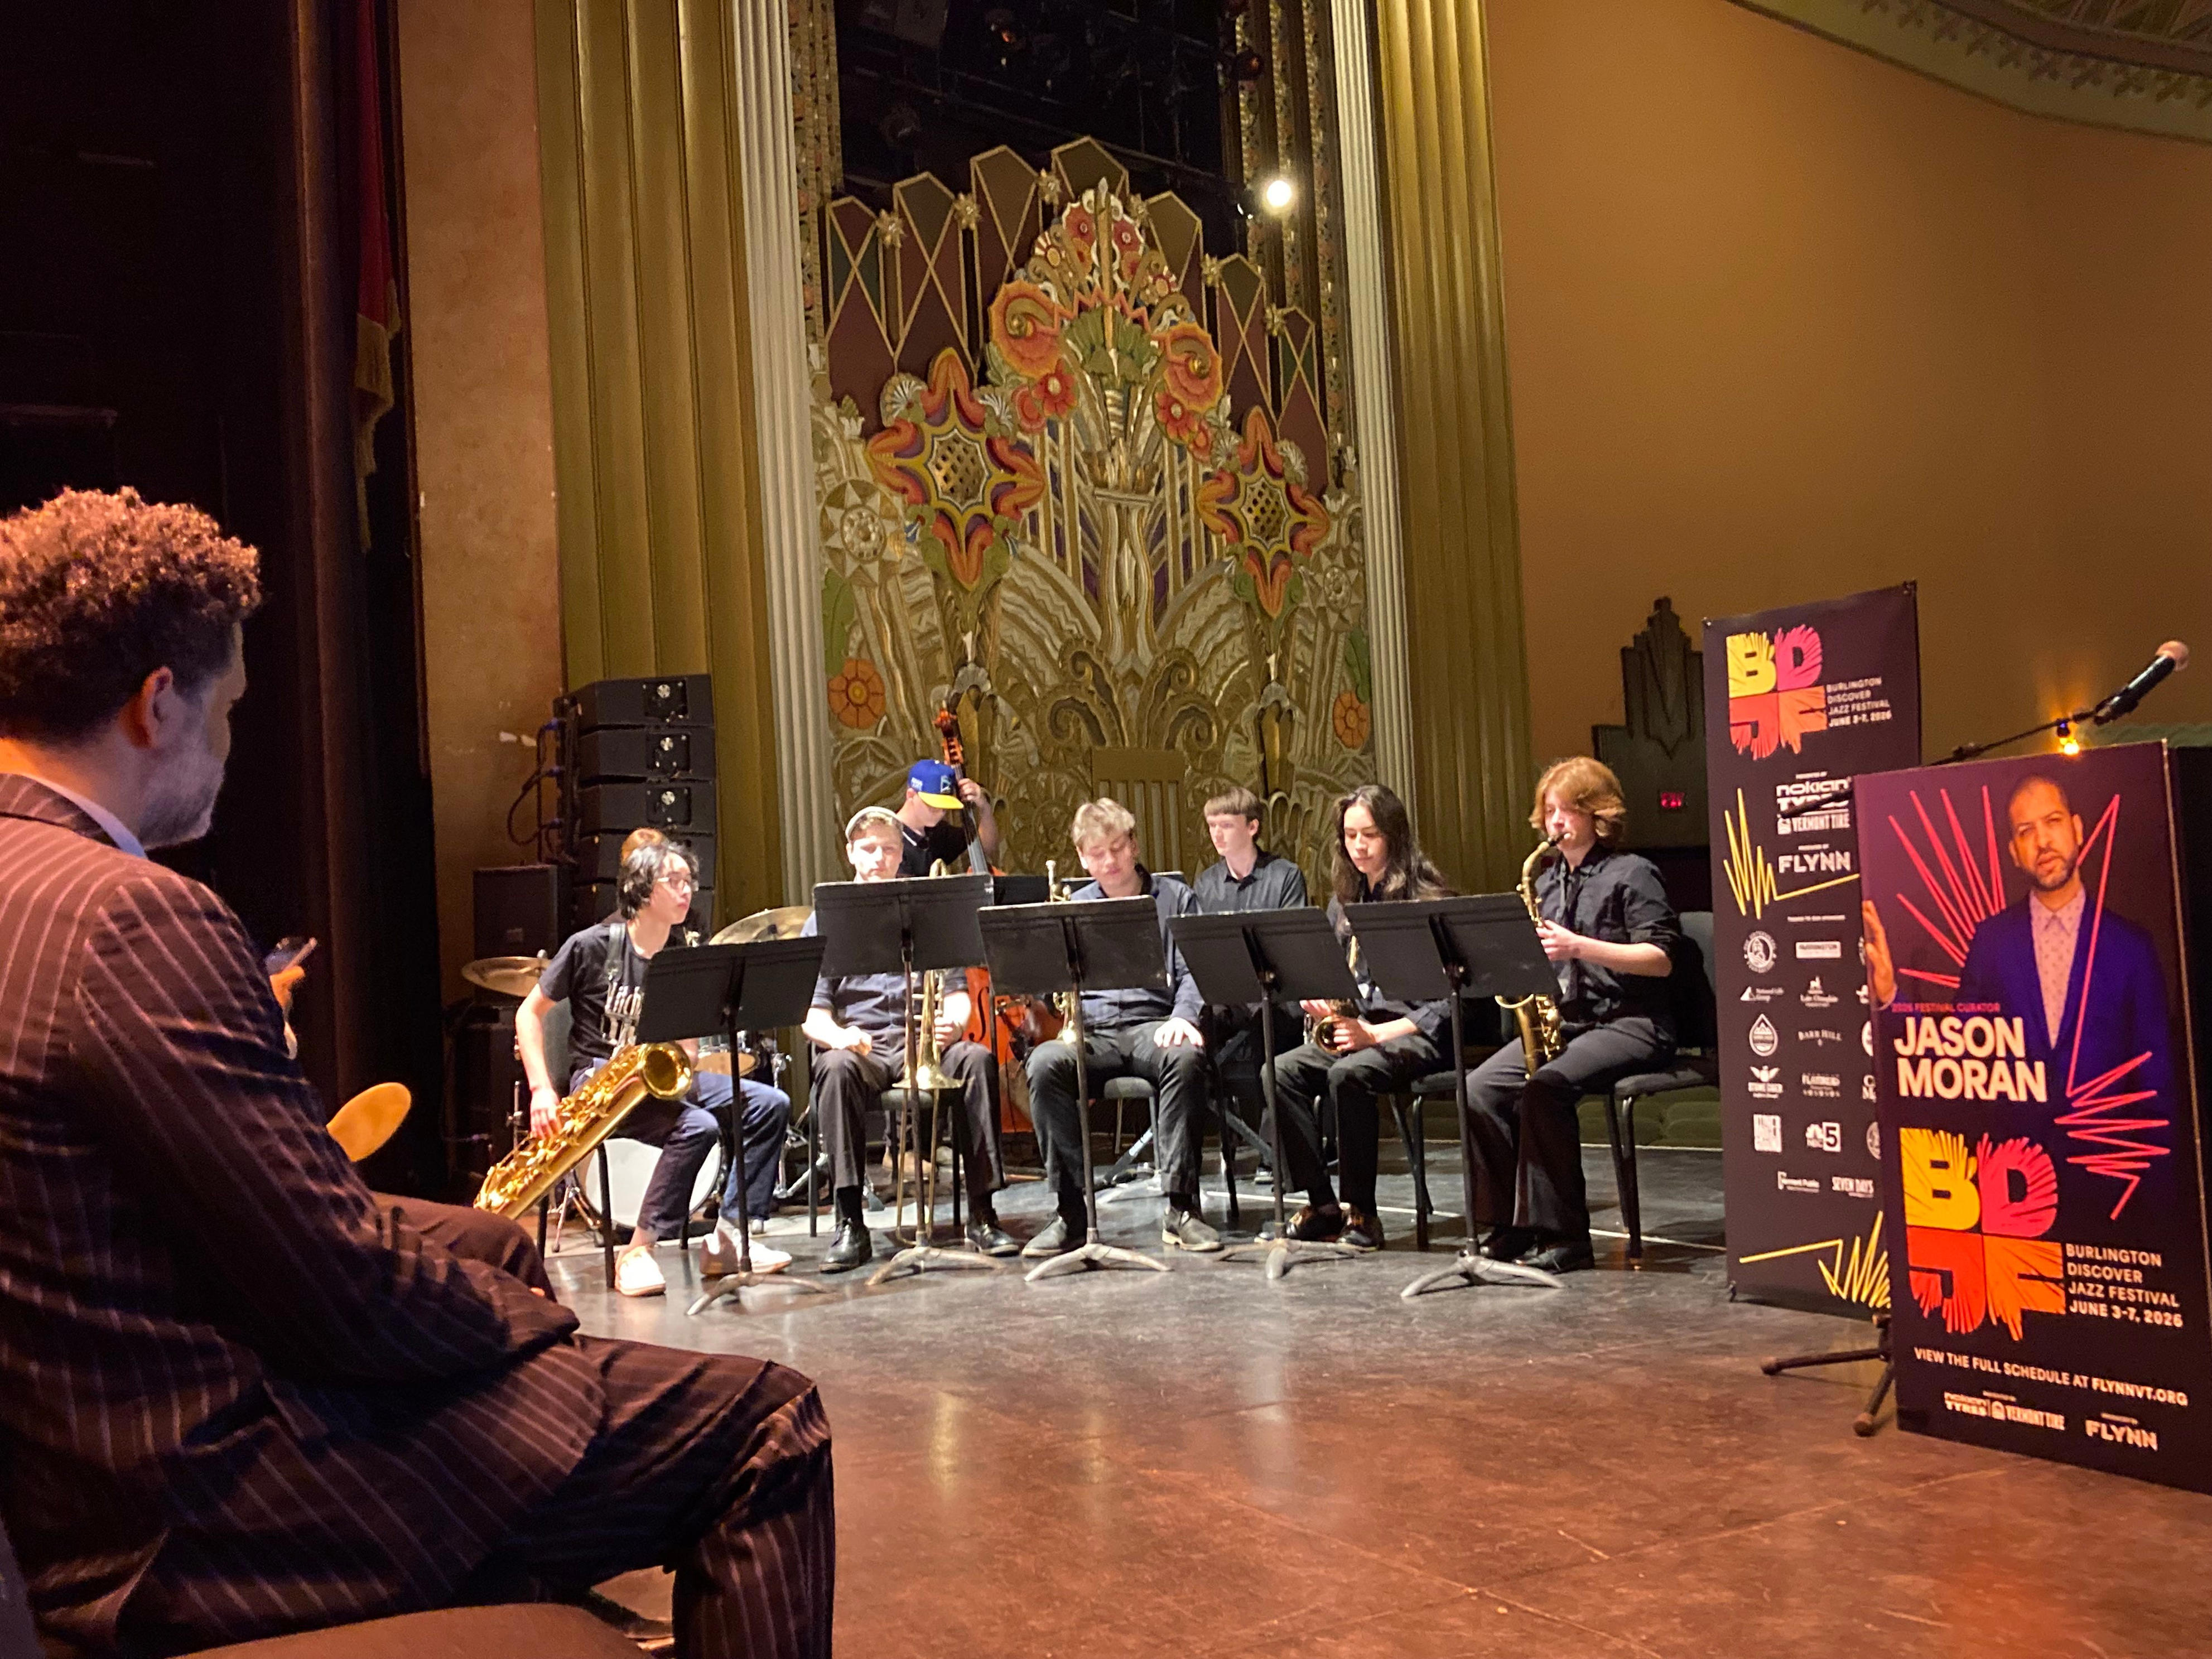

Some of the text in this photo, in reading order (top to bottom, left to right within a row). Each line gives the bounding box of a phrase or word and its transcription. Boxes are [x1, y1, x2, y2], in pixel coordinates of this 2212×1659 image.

[1827, 676, 1882, 693] BURLINGTON
[1827, 689, 1871, 704] DISCOVER
[1828, 699, 1890, 716] JAZZ FESTIVAL
[1829, 716, 1851, 727] JUNE
[1778, 850, 1852, 874] FLYNN
[1893, 1016, 2026, 1058] JASON
[1897, 1057, 2048, 1102] MORAN
[1826, 1126, 1838, 1147] 5
[2065, 1242, 2162, 1267] BURLINGTON
[2066, 1261, 2143, 1284] DISCOVER
[2068, 1281, 2180, 1308] JAZZ FESTIVAL
[2069, 1299, 2184, 1328] JUNE 3-7, 2026
[1913, 1346, 2189, 1406] VIEW THE FULL SCHEDULE AT FLYNNVT.ORG
[2085, 1419, 2158, 1451] FLYNN
